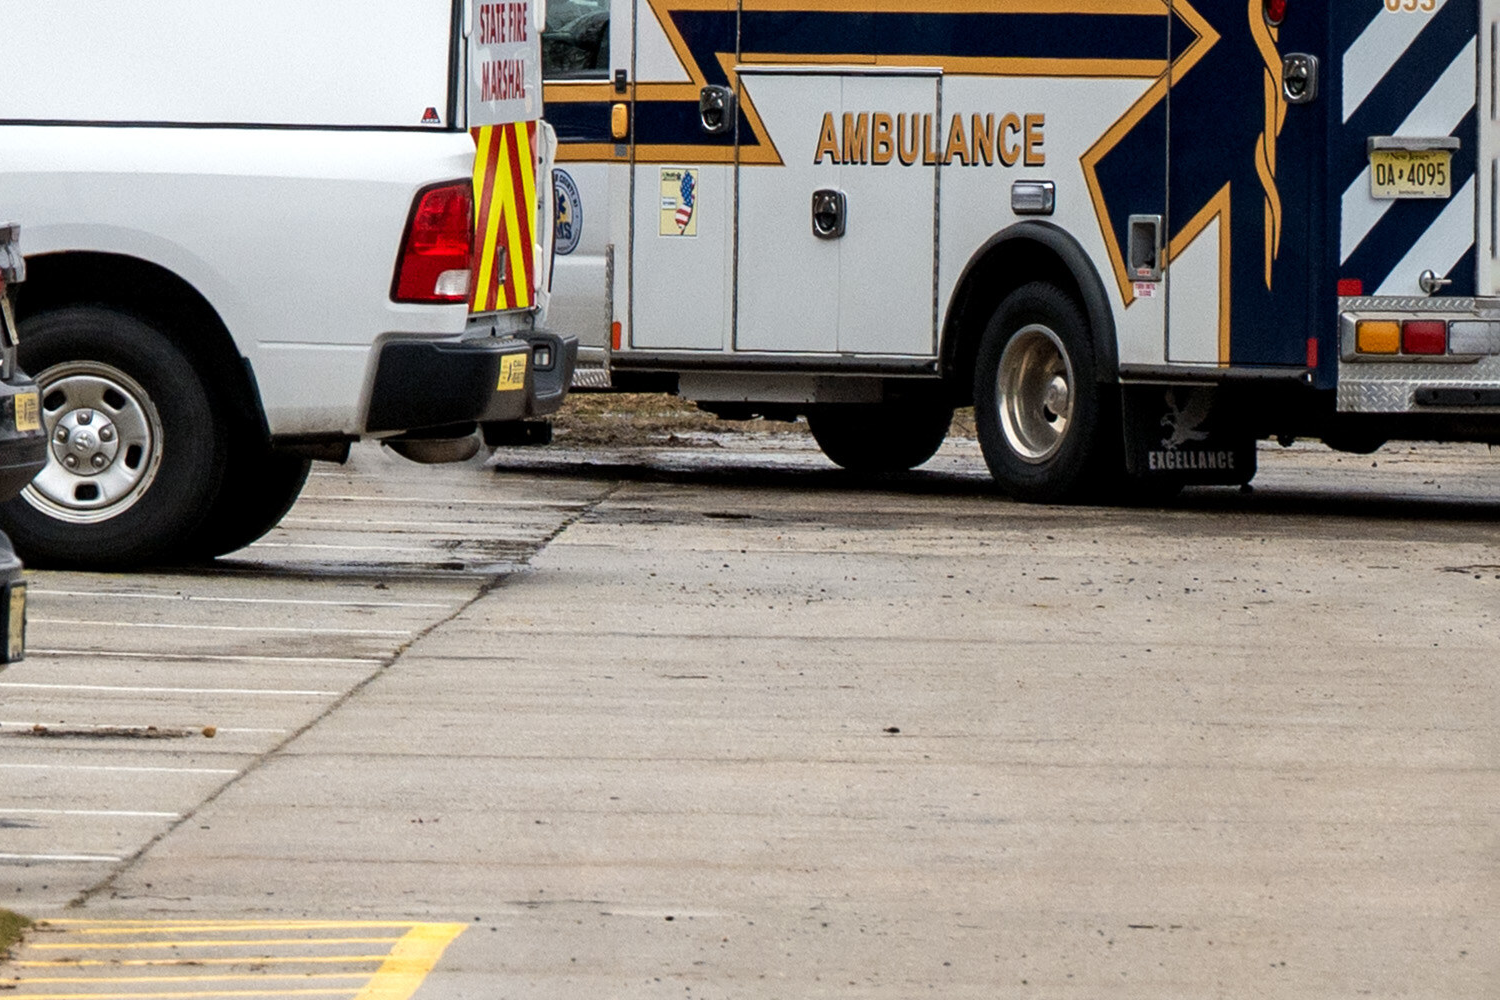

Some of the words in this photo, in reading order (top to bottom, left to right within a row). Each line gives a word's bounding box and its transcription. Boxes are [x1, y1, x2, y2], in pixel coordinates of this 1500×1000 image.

[480, 3, 506, 44] STATE
[508, 2, 527, 42] FIRE
[481, 59, 526, 102] MARSHAL
[813, 111, 1046, 167] AMBULANCE
[1407, 163, 1446, 186] 4095
[1148, 451, 1235, 470] EXCELLANCE
